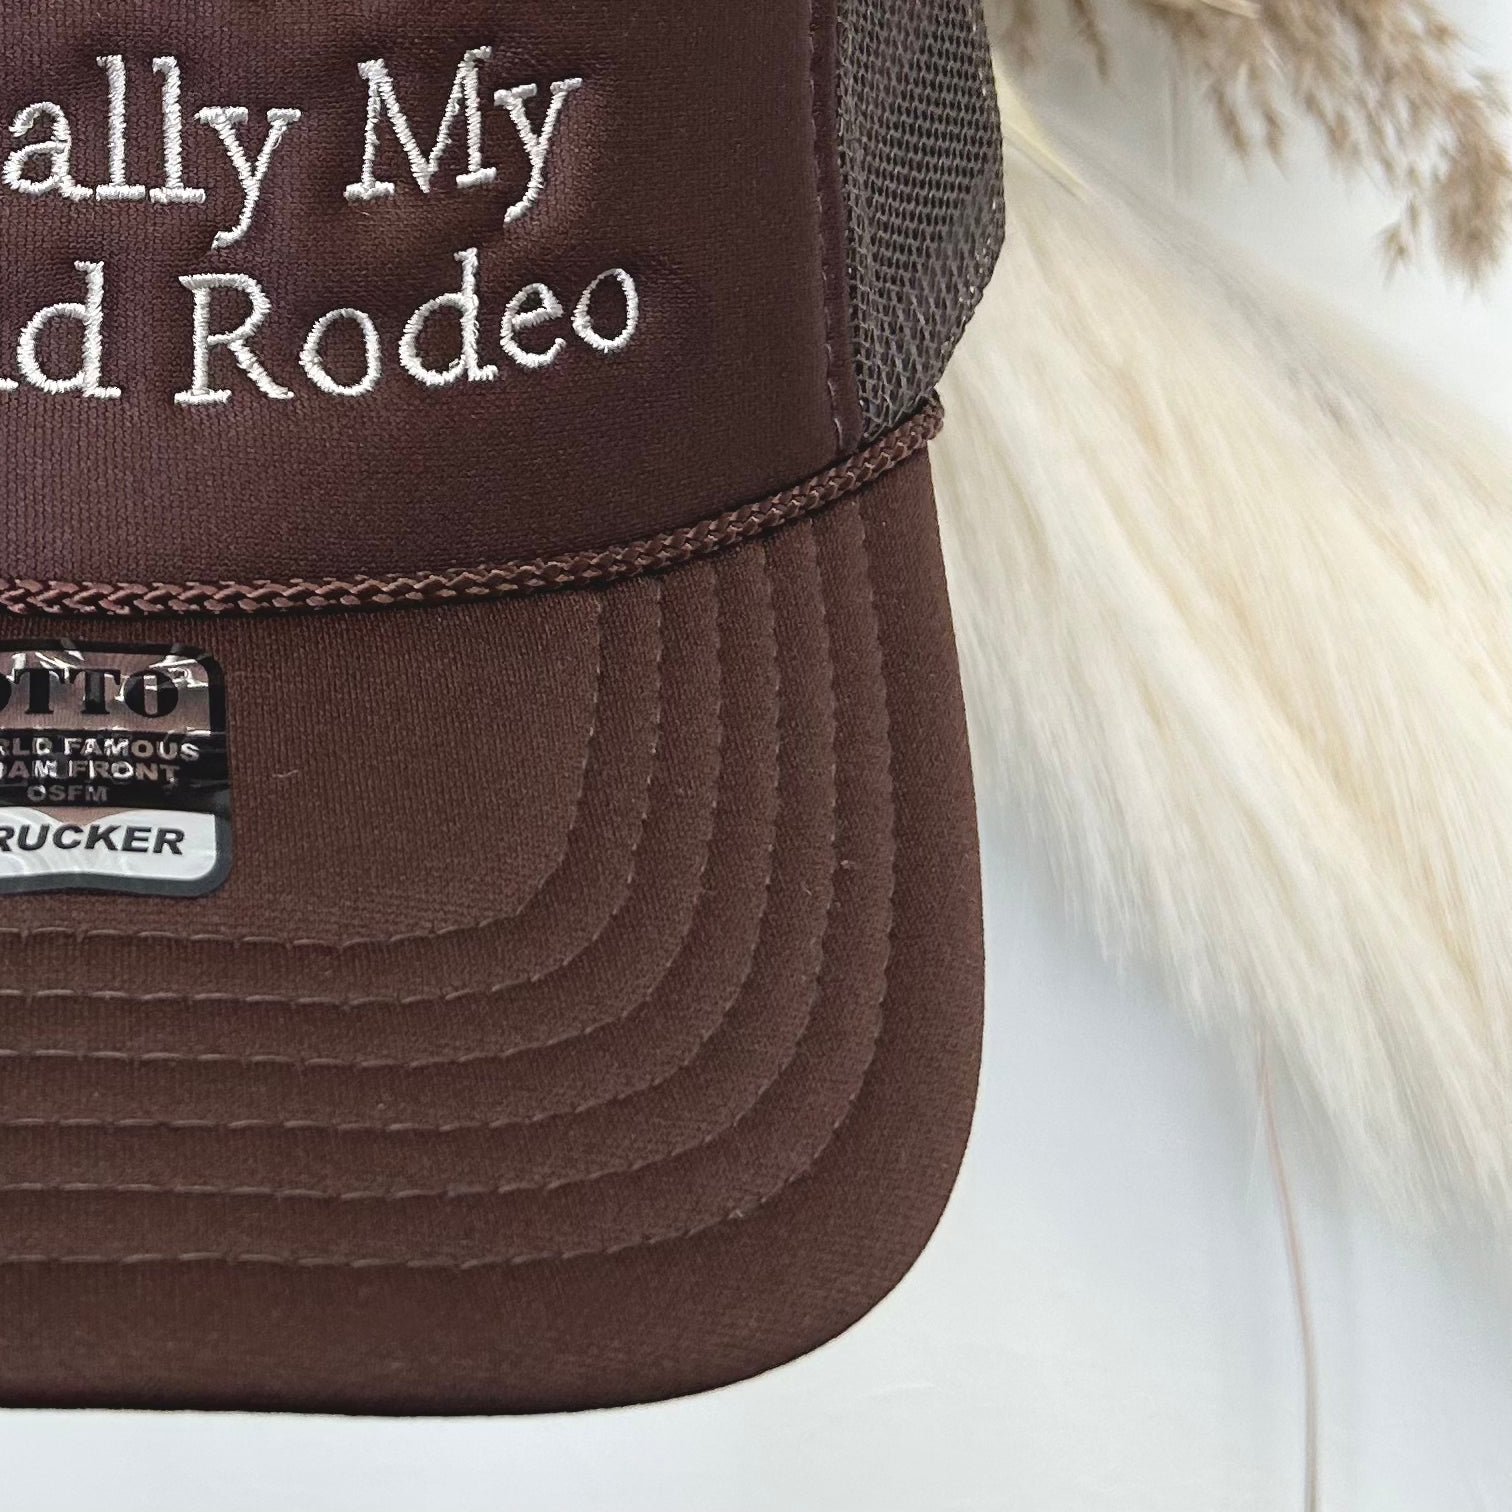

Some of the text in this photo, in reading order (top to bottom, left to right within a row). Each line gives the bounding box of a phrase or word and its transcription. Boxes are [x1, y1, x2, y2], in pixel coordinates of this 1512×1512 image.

[344, 45, 583, 222] My
[174, 248, 639, 407] Rodeo
[64, 738, 200, 761] FAMOUS
[68, 761, 180, 782] FRONT
[27, 785, 108, 802] OSFM
